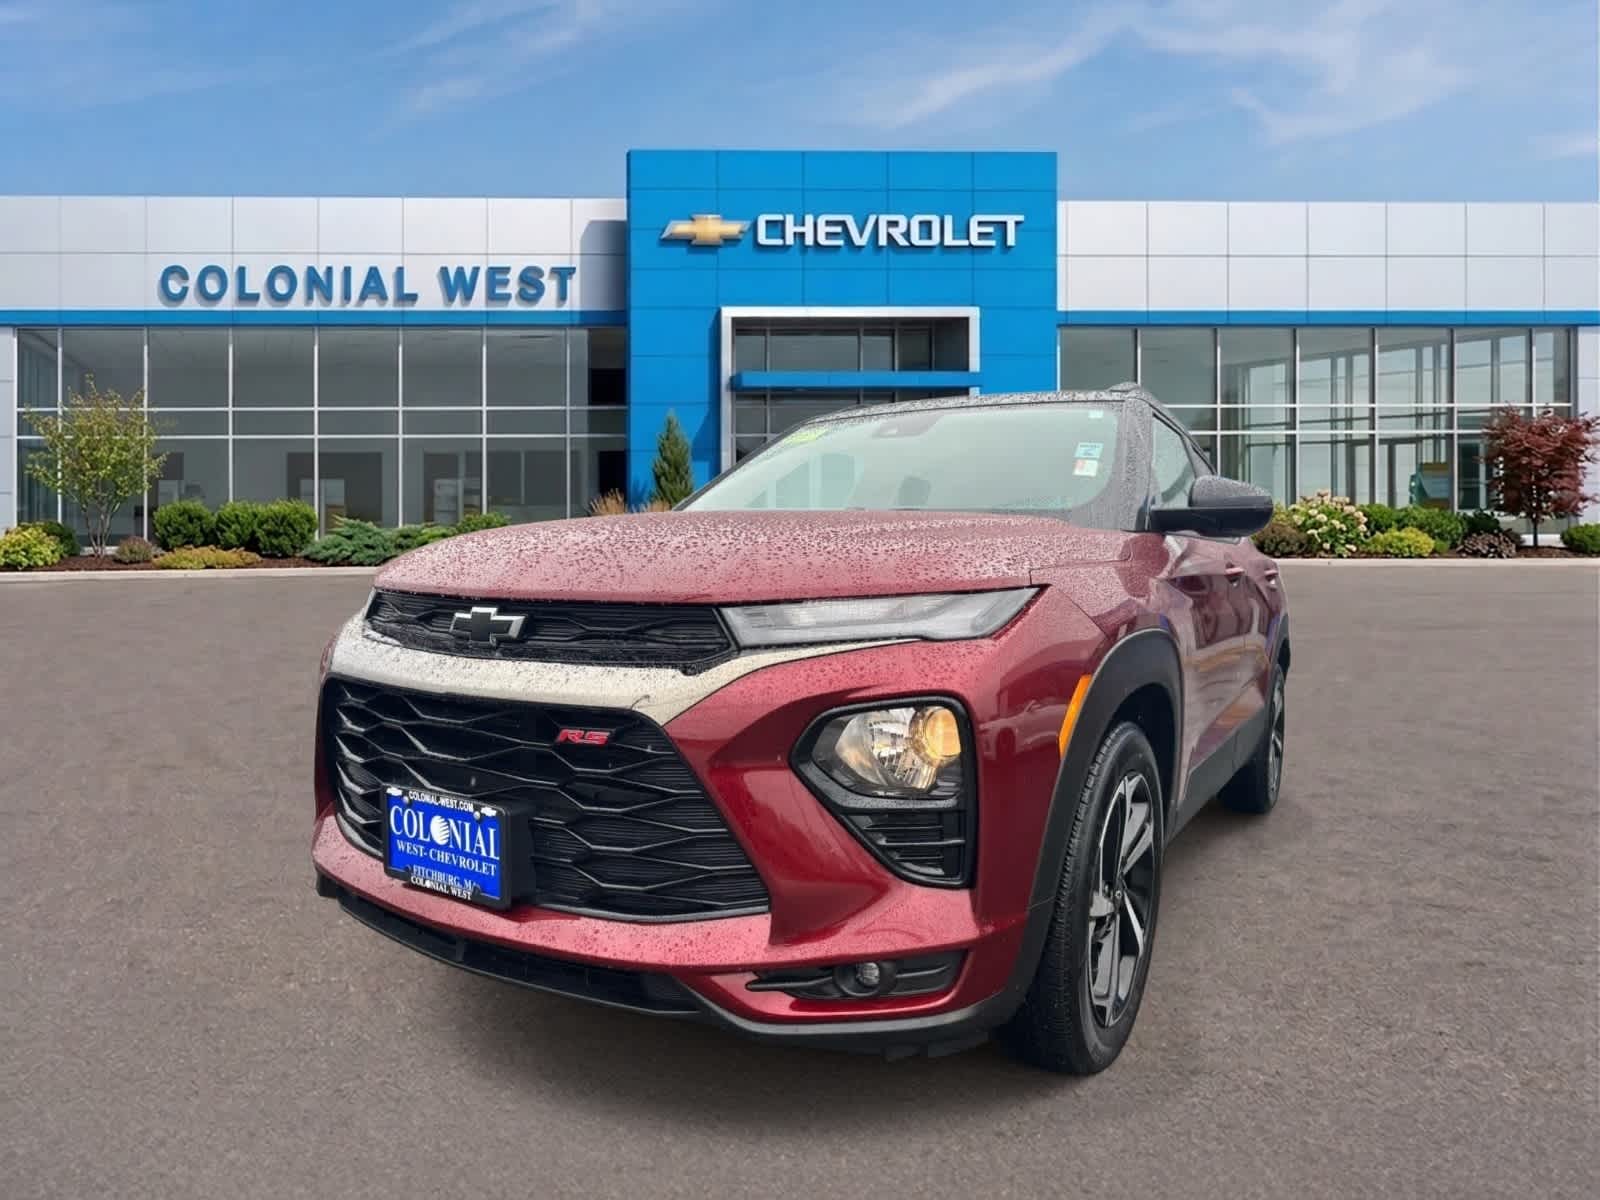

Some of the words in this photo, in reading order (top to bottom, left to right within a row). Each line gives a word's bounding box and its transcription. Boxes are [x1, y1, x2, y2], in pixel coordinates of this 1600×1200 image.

[757, 213, 1025, 247] CHEVROLET
[159, 264, 419, 302] COLONIAL
[437, 265, 578, 302] WEST
[556, 728, 611, 745] RS
[389, 805, 500, 860] COLONIAL
[428, 848, 497, 876] CHEVROLET
[410, 875, 450, 894] COLONIAL
[450, 886, 473, 900] WEST
